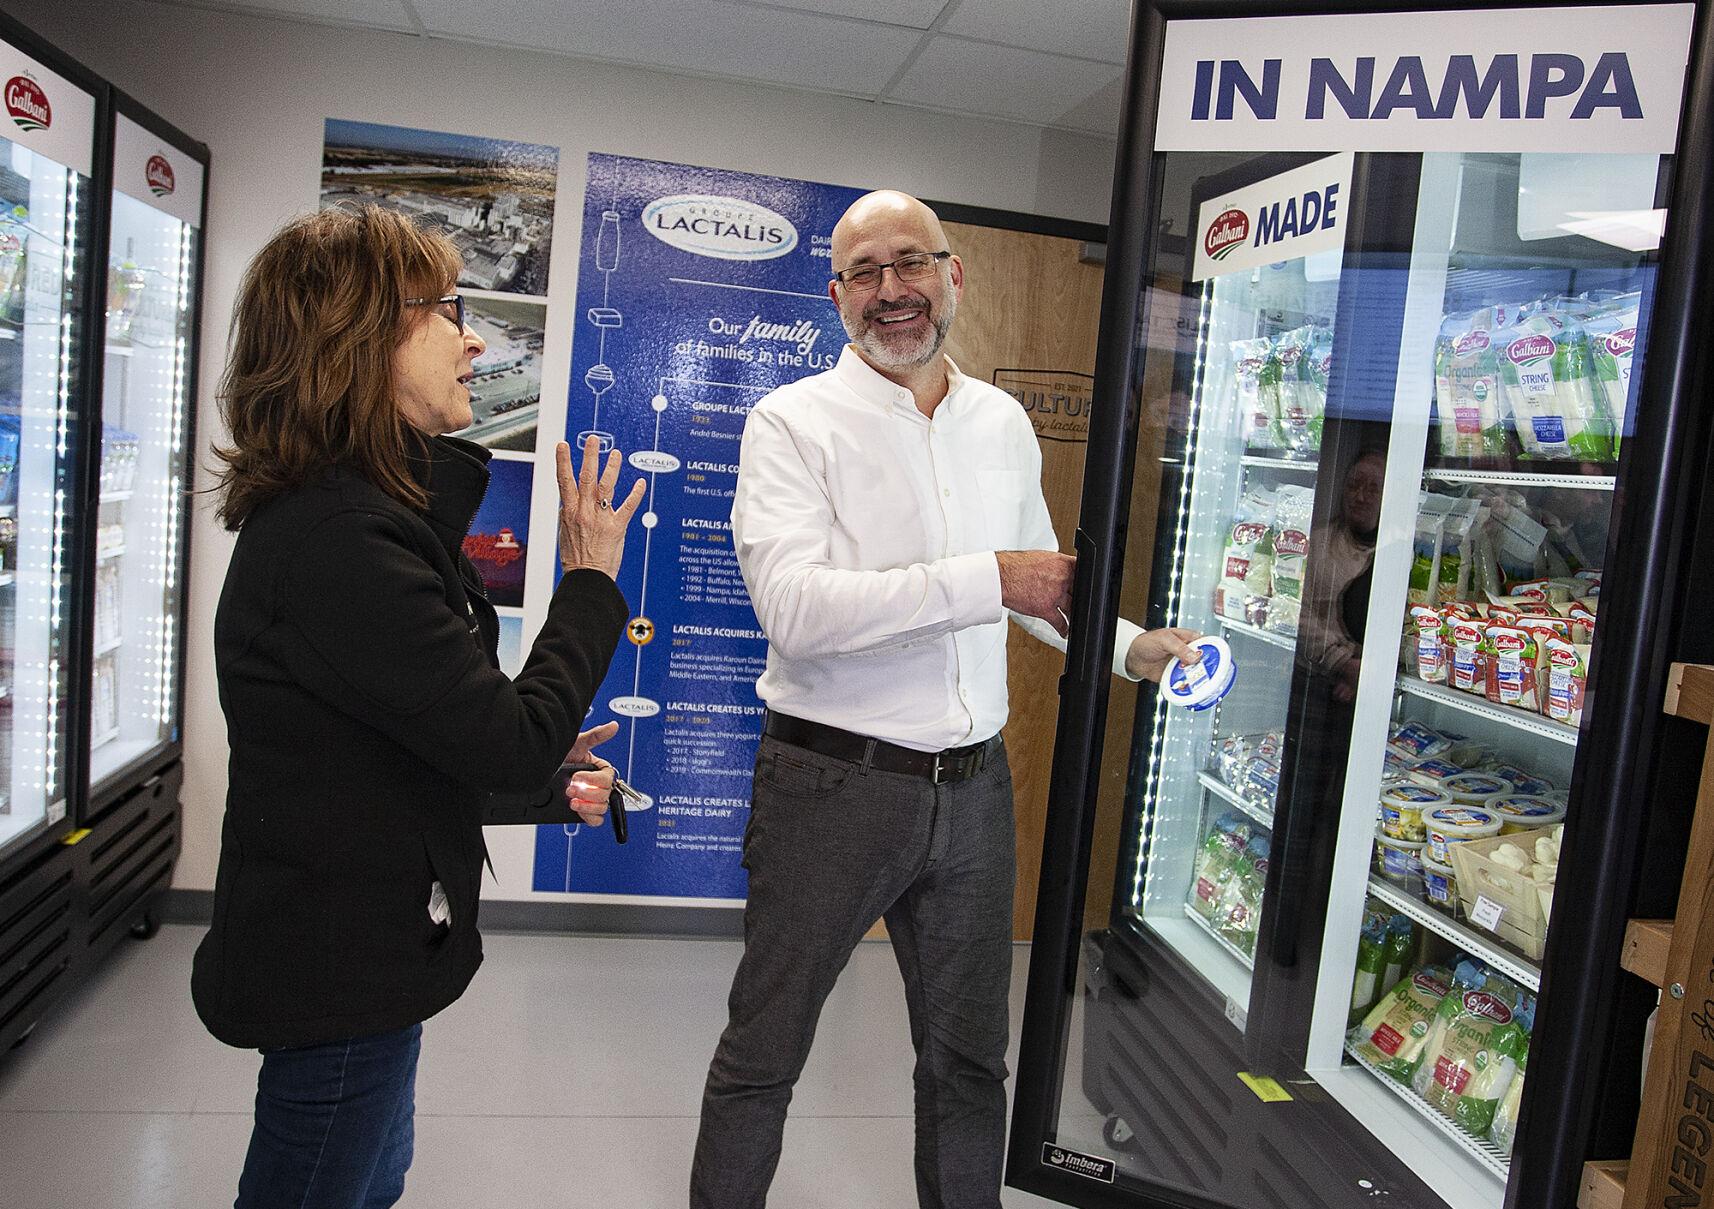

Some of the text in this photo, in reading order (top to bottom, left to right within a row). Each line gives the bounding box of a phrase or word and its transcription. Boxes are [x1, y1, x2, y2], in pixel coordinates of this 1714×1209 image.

[1191, 52, 1644, 121] IN NAMPA
[9, 85, 48, 122] Galbani
[689, 207, 754, 221] GROUPE
[1208, 183, 1340, 248] Galbani MADE
[709, 315, 821, 355] Our family
[676, 339, 695, 355] of
[697, 340, 754, 361] families
[758, 347, 773, 363] in
[778, 350, 803, 367] the
[1511, 343, 1550, 358] Galbani
[1521, 373, 1549, 385] STRING
[692, 401, 728, 413] GROUPE
[687, 461, 726, 472] LACTALIS
[683, 486, 696, 494] The
[697, 487, 709, 496] first
[682, 518, 721, 529] LACTALIS
[680, 545, 692, 553] The
[693, 548, 728, 557] acquisition
[708, 567, 737, 576] Belmont,
[707, 577, 731, 586] Buffalo,
[706, 587, 731, 595] Nampa,
[705, 596, 727, 604] Merrill,
[673, 625, 712, 636] LACTALIS
[713, 628, 755, 638] ACQUIRES
[671, 652, 694, 660] Lactalis
[696, 655, 722, 663] acquires
[669, 661, 697, 670] business
[698, 663, 736, 673] specializing
[669, 671, 692, 679] Middle
[667, 702, 705, 712] LACTALIS
[707, 704, 742, 714] CREATES
[665, 728, 688, 736] Lactalis
[690, 731, 716, 739] acquires
[717, 732, 734, 740] three
[735, 733, 756, 741] yogurt
[691, 767, 741, 776] Commonwealth
[659, 795, 701, 806] LACTALIS
[703, 797, 743, 807] CREATES
[658, 807, 732, 818] HERITAGE DAIRY
[657, 832, 680, 840] Lactalis
[675, 842, 705, 851] Company
[1065, 1153, 1104, 1172] Imbera
